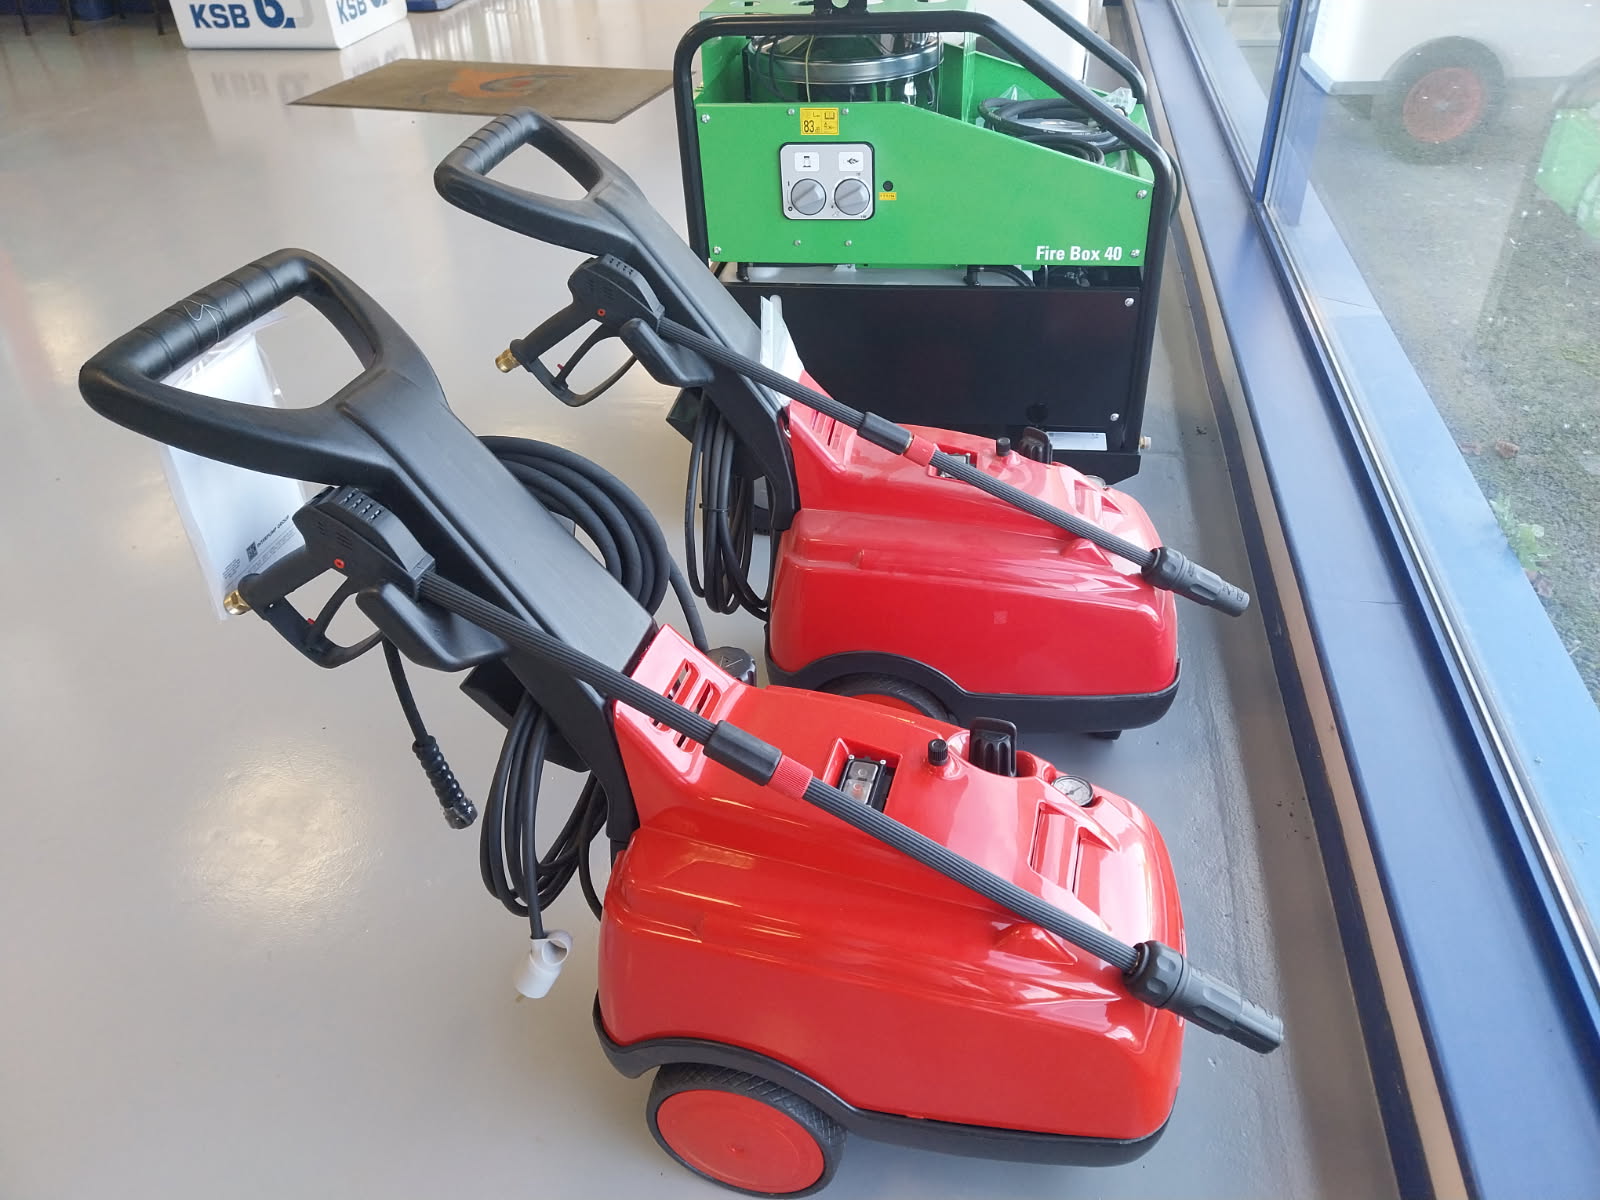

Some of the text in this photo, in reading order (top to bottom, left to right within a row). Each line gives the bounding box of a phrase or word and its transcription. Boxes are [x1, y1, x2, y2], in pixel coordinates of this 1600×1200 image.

[189, 4, 250, 28] KSB
[336, 0, 368, 25] KSB
[803, 120, 815, 133] 83
[1036, 245, 1123, 261] Fire Box 40
